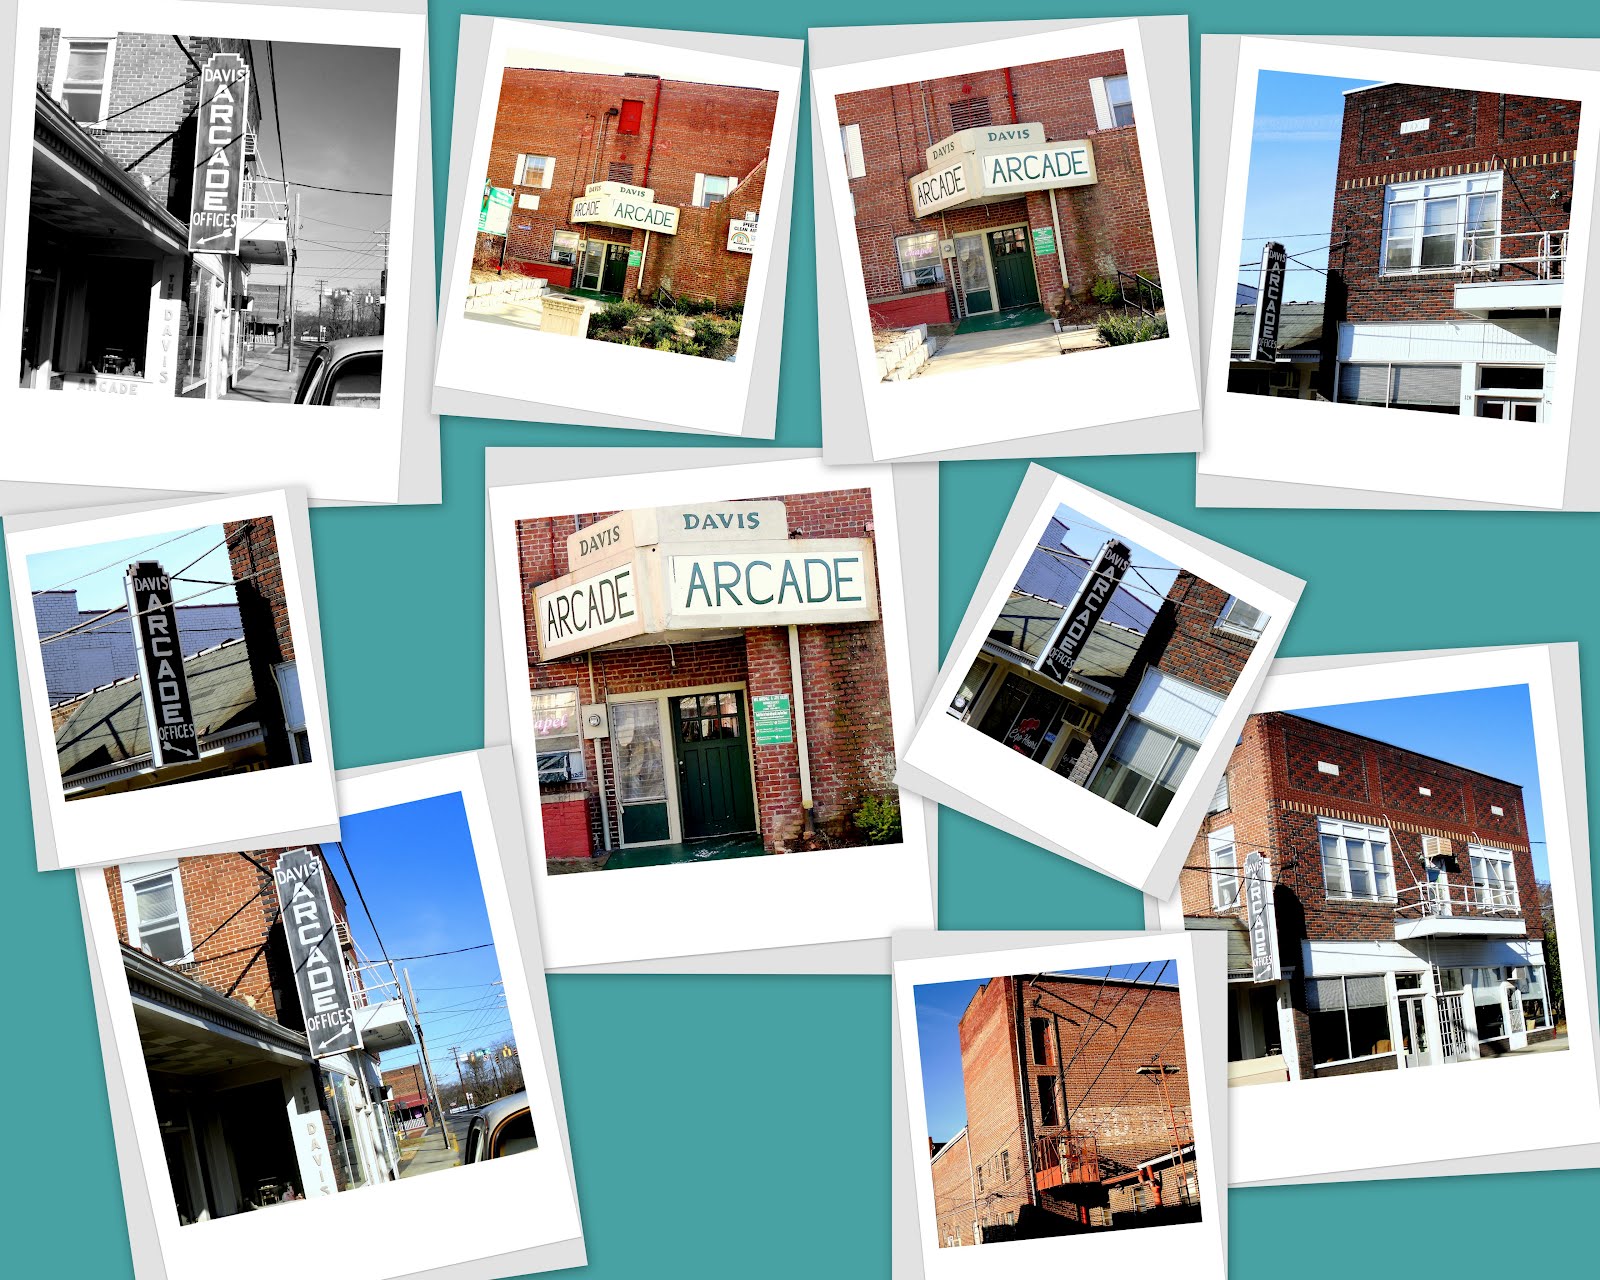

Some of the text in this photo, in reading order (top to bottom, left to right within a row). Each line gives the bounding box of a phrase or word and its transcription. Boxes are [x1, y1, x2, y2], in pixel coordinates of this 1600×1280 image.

[205, 69, 244, 82] DAVIS
[988, 129, 1030, 142] DAVIS
[204, 84, 234, 211] ARCADE
[932, 141, 955, 160] DAVIS
[992, 149, 1088, 184] ARCADE
[620, 186, 646, 197] DAVIS
[917, 165, 965, 207] ARCADE
[574, 200, 600, 217] ARCADE
[614, 202, 675, 228] ARCADE
[193, 212, 238, 228] OFFICES
[1268, 250, 1286, 262] DAVIS
[1263, 261, 1280, 339] ARCADE
[1258, 337, 1277, 349] OFFICES
[683, 511, 760, 530] DAVIS
[579, 525, 620, 557] DAVIS
[1105, 549, 1129, 571] DAVIS
[133, 576, 169, 592] DAVIS
[685, 557, 862, 608] ARCADE
[547, 570, 635, 642] ARCADE
[1060, 566, 1115, 656] ARCADE
[147, 593, 184, 724] ARCADE
[1049, 647, 1075, 669] OFFICES
[158, 723, 195, 741] OFFICES
[277, 861, 318, 885] DAVIS
[1245, 860, 1264, 875] DAVIS
[1251, 873, 1267, 956] ARCADE
[292, 882, 339, 1014] ARCADE
[1253, 955, 1272, 967] OFFICES
[307, 1008, 353, 1032] OFFICES
